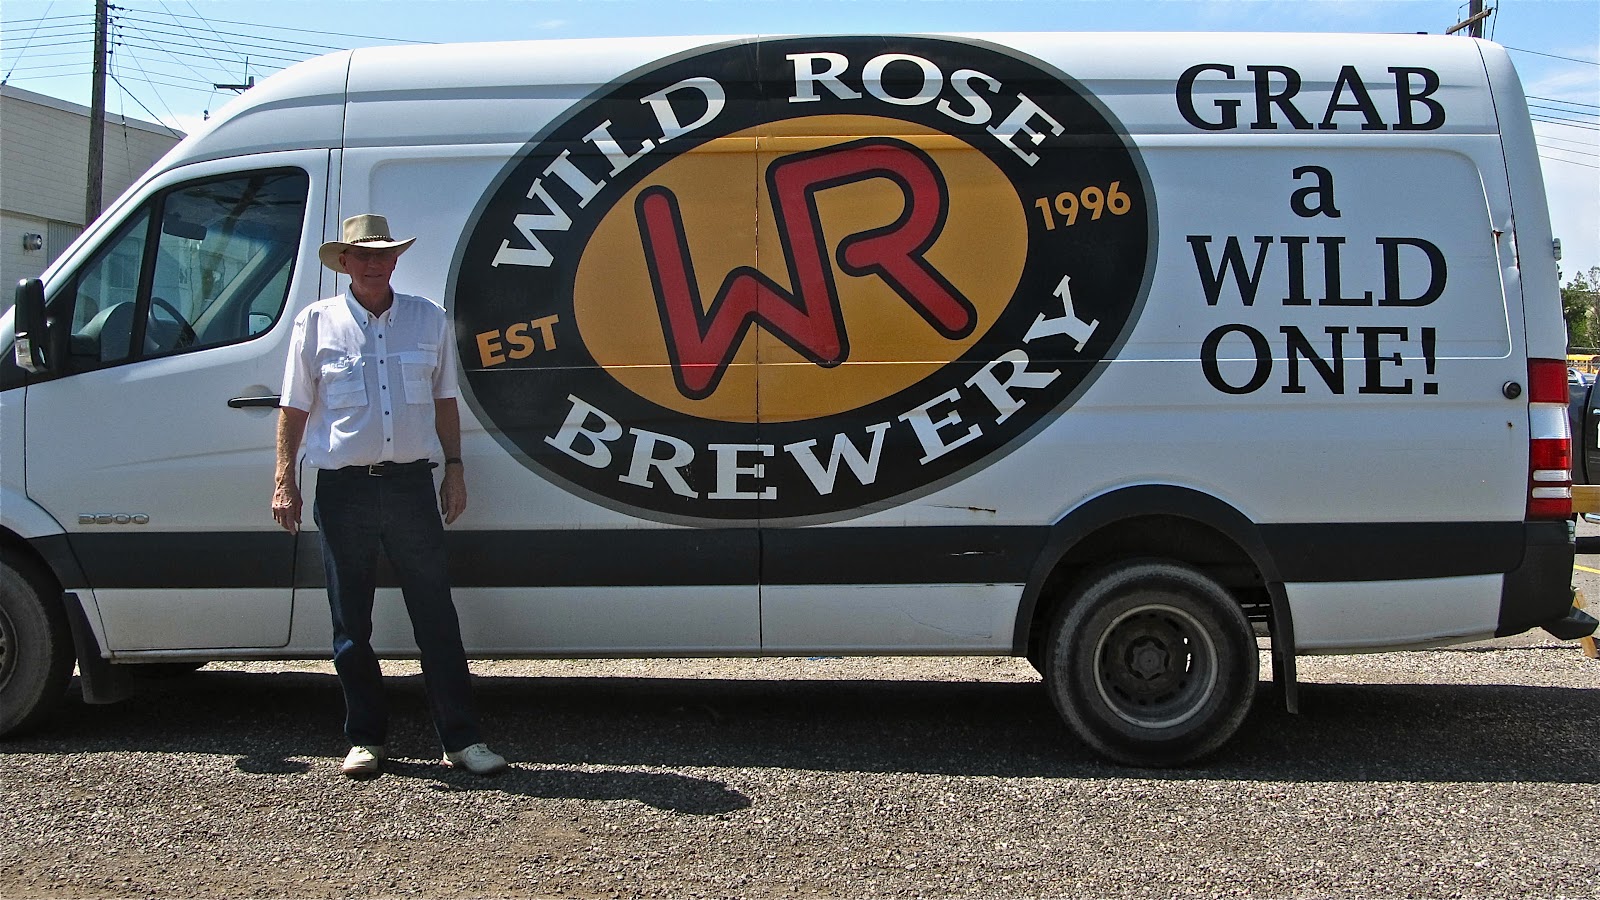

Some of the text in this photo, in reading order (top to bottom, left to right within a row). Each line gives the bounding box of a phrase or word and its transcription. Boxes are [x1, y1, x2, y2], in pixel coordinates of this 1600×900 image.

[1175, 63, 1446, 131] GRAB
[491, 52, 1065, 267] WILD ROSE
[1289, 165, 1341, 218] a
[1034, 181, 1131, 231] 1996
[1186, 235, 1448, 306] WILD
[475, 314, 560, 368] EST
[1200, 323, 1439, 395] ONE!
[543, 274, 1100, 500] BREWERY
